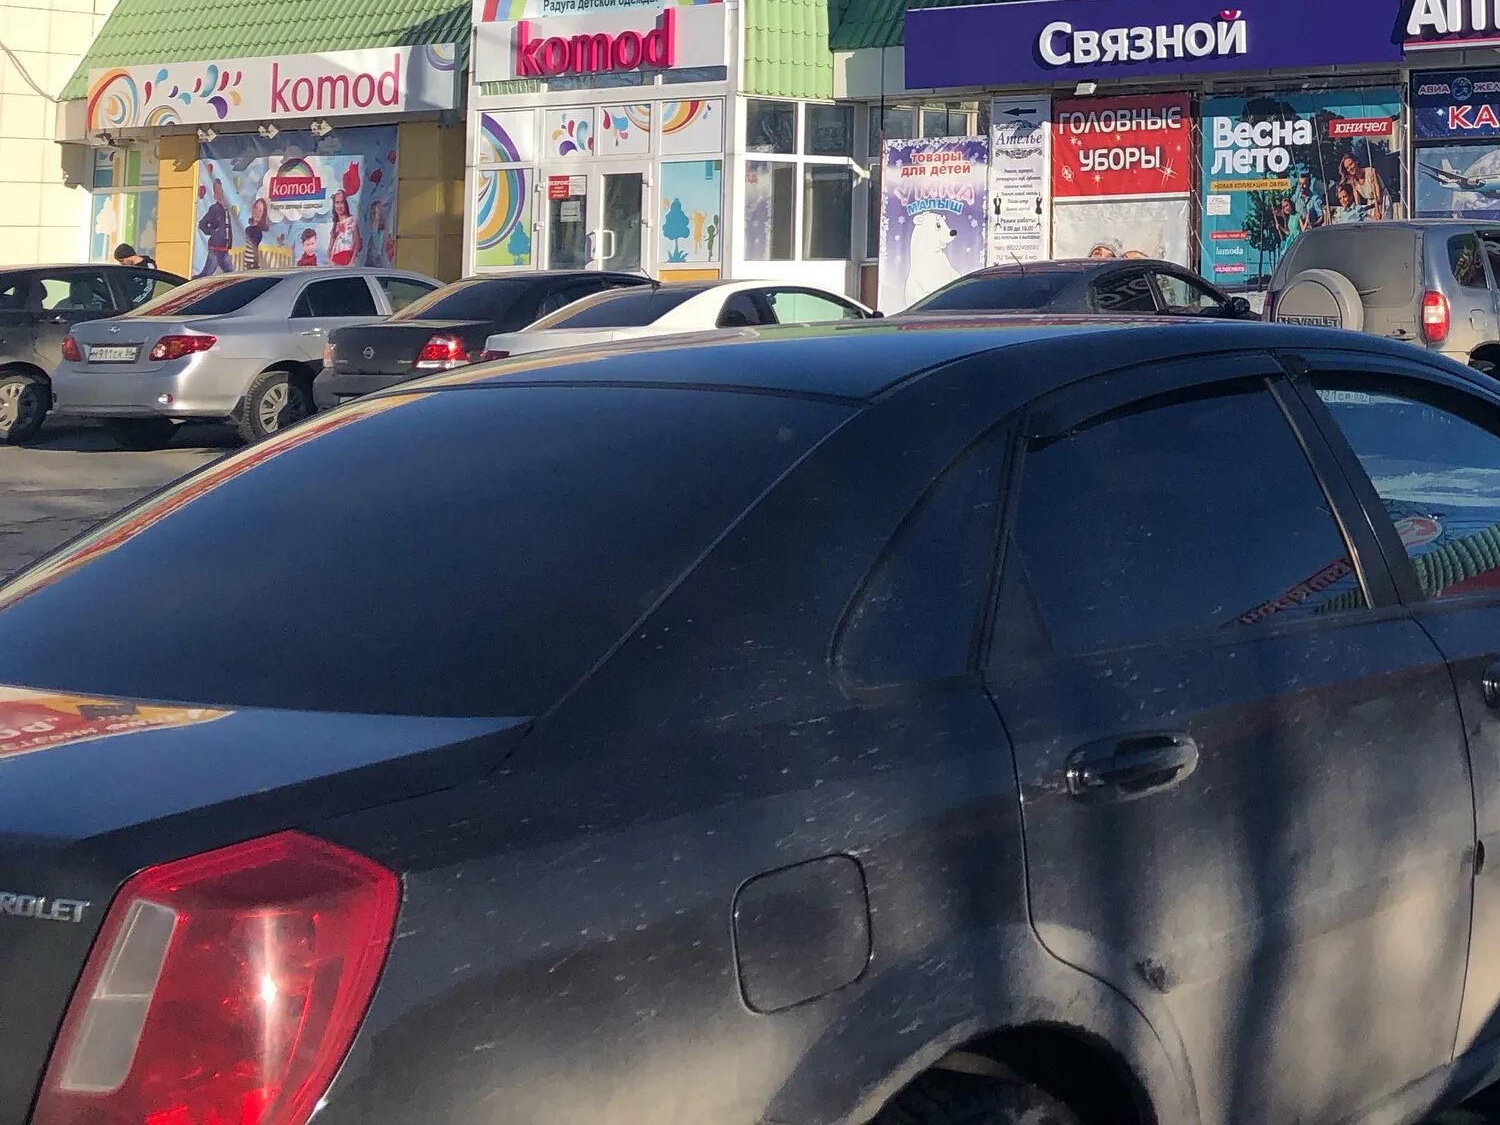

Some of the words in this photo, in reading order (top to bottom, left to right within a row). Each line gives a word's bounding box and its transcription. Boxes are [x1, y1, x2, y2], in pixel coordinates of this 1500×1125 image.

[543, 0, 576, 13] Радуга
[516, 7, 676, 77] komod
[1039, 10, 1248, 66] Связной
[270, 53, 400, 114] komod
[1418, 84, 1450, 95] АВИА
[1058, 107, 1181, 135] ГОЛОВНЫЕ
[996, 132, 1042, 145] Ателье
[1213, 116, 1313, 148] Весна
[912, 152, 961, 164] товары
[1078, 147, 1161, 172] УБОРЫ
[901, 166, 926, 178] для
[930, 162, 971, 177] детей
[272, 178, 316, 195] komod
[907, 198, 964, 216] МАЛЫШ
[1216, 246, 1244, 255] lamoda
[0, 891, 91, 923] ROLET
